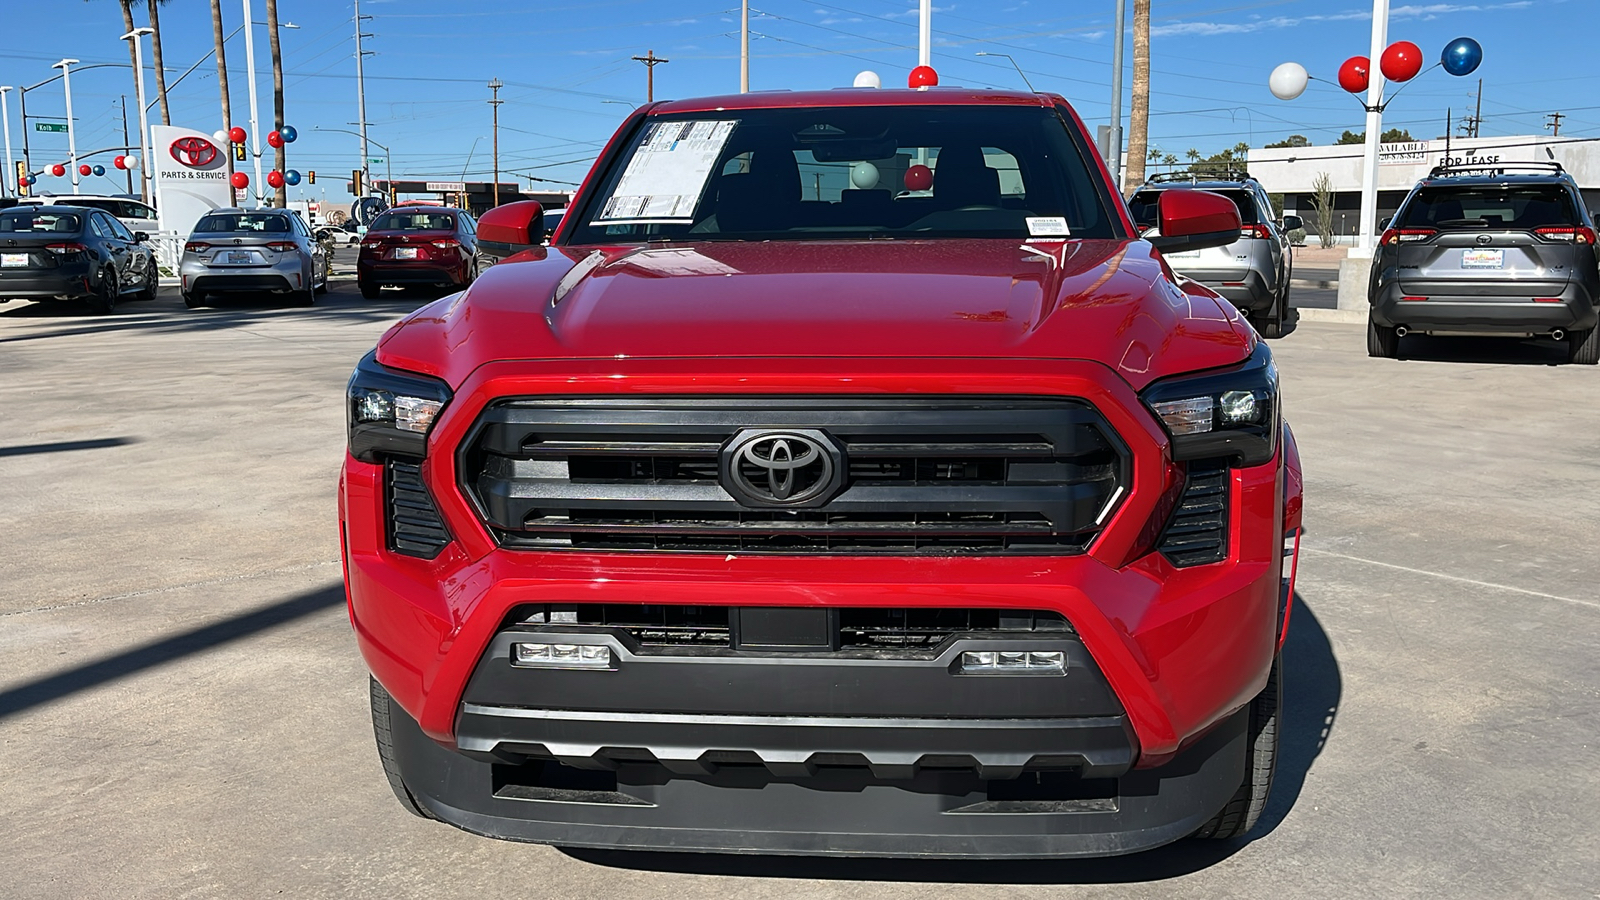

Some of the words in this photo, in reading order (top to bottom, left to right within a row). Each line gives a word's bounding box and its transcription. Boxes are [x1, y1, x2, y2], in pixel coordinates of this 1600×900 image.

[1379, 143, 1427, 152] VAILABLE
[1440, 157, 1462, 167] FOR
[1466, 155, 1500, 165] LEASE
[161, 171, 187, 179] PARTS
[188, 171, 194, 179] &
[196, 171, 226, 180] SERVICE
